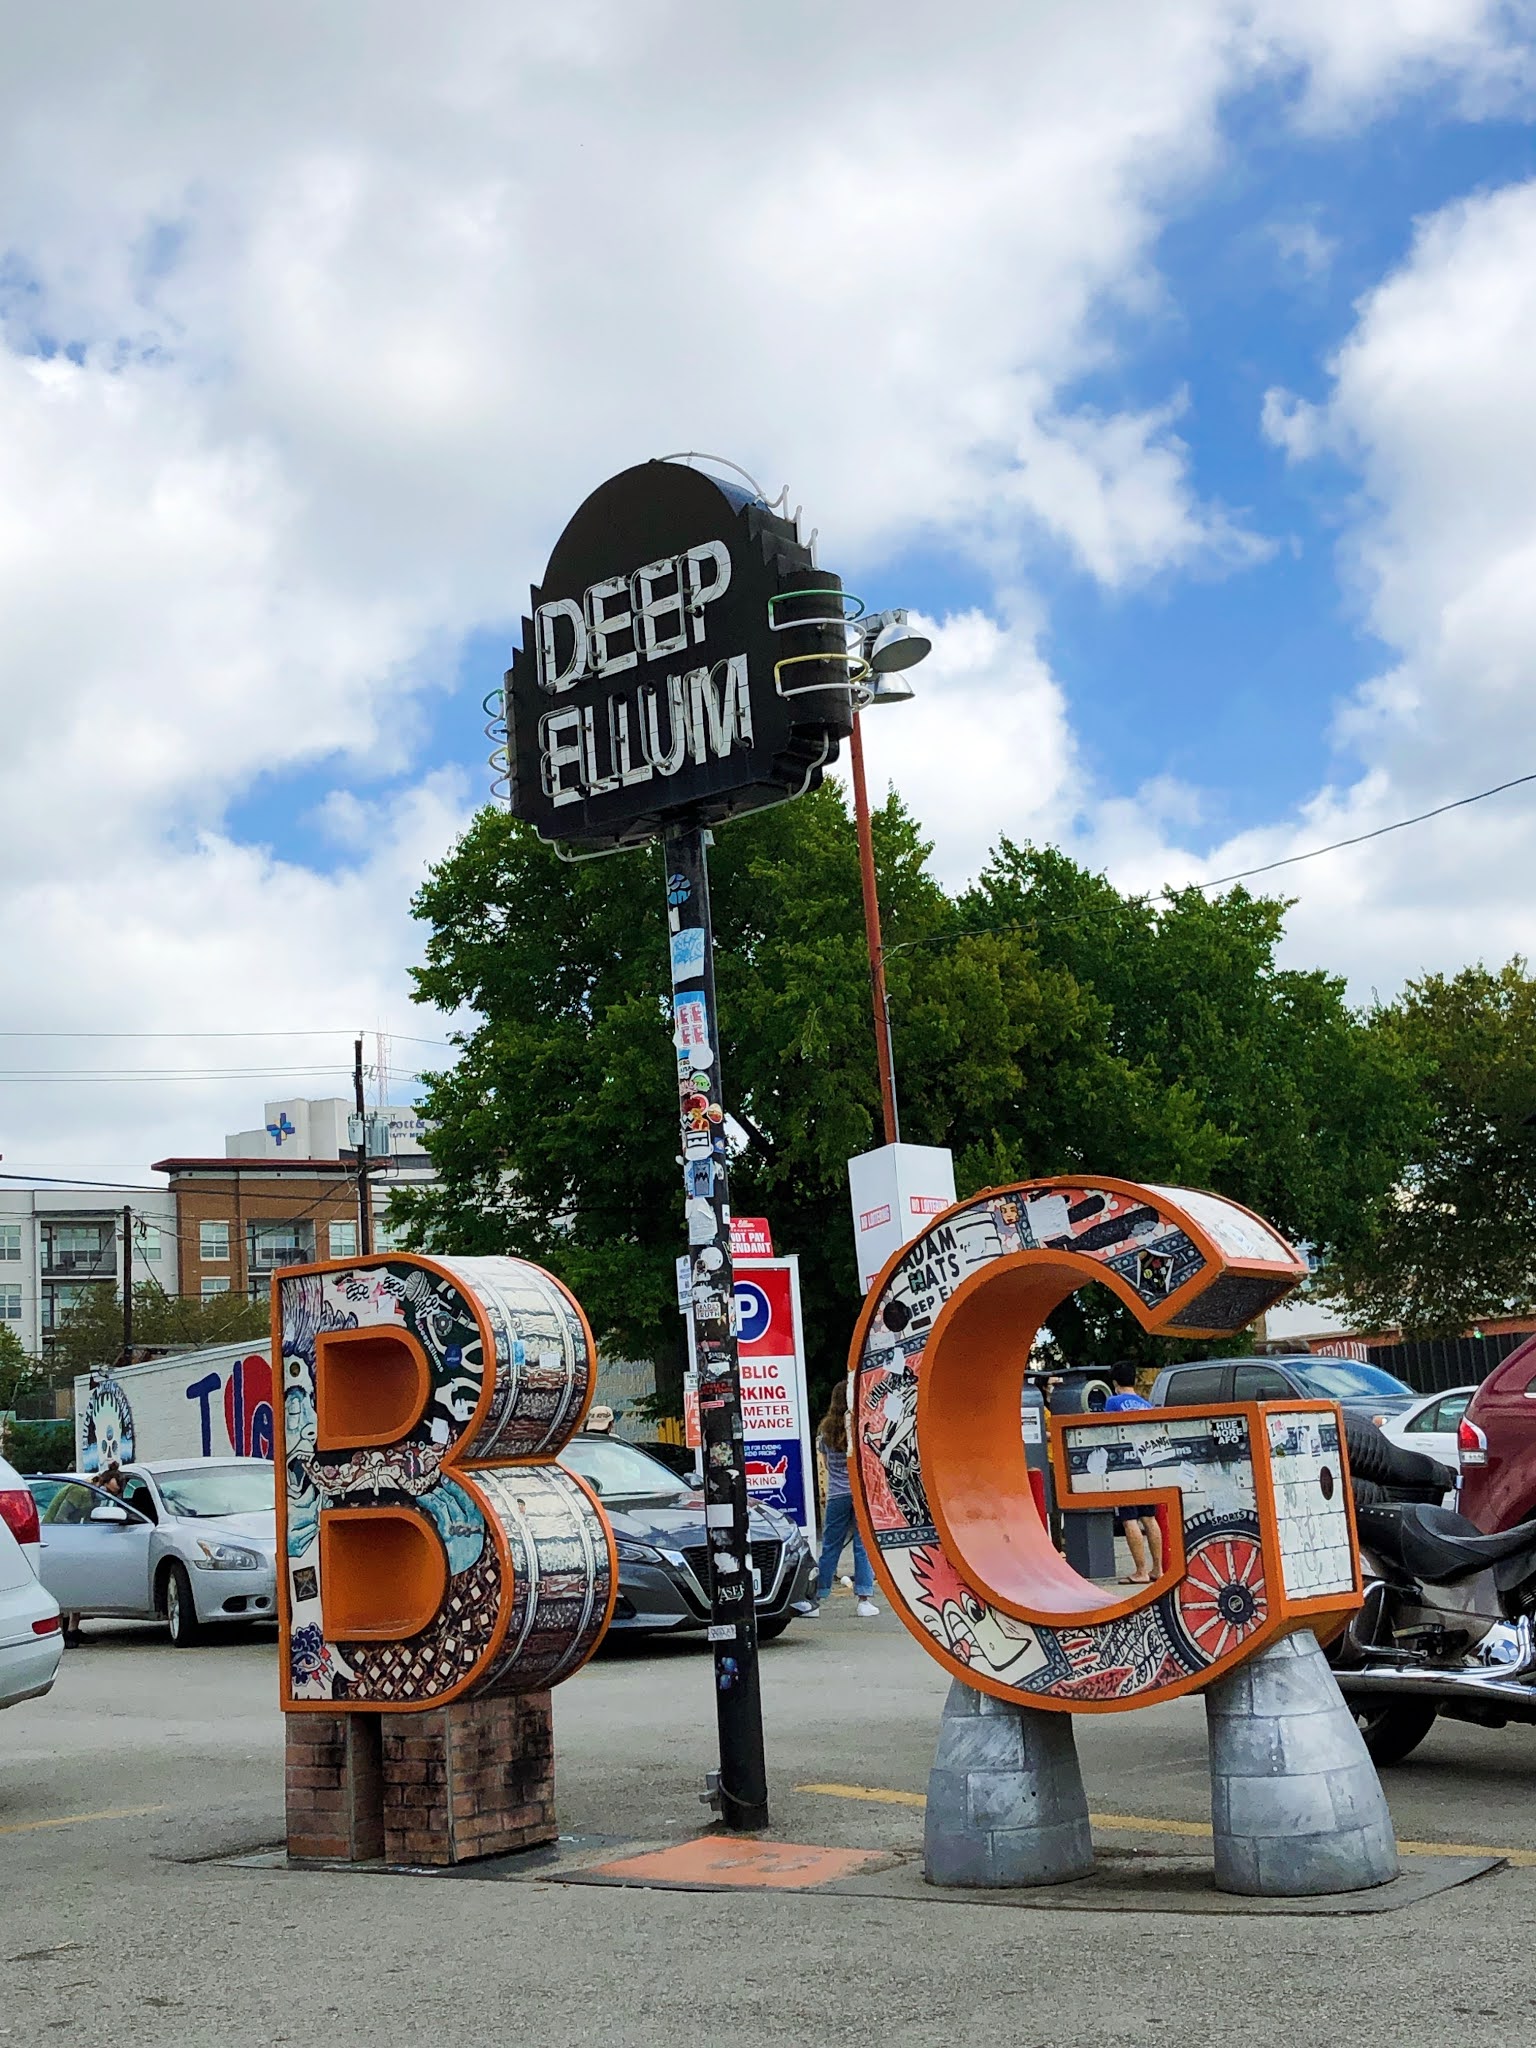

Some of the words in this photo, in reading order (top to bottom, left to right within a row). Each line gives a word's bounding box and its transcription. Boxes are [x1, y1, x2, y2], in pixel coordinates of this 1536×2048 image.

[535, 540, 731, 696] DEEP
[539, 652, 754, 808] ELLUM
[730, 1232, 746, 1242] NOT
[748, 1232, 765, 1242] PAY
[731, 1242, 771, 1254] ENDANT
[902, 1226, 957, 1273] ADAM
[908, 1253, 960, 1294] ATS
[734, 1293, 759, 1332] P
[741, 1365, 779, 1379] BLIC
[740, 1385, 787, 1400] RKING
[743, 1405, 790, 1416] METER
[742, 1418, 793, 1430] DVANCE
[1216, 1421, 1238, 1430] HUE
[1213, 1428, 1243, 1438] MORE
[1218, 1436, 1240, 1445] AFO
[746, 1476, 777, 1486] RKING
[1212, 1510, 1245, 1526] SPORTS
